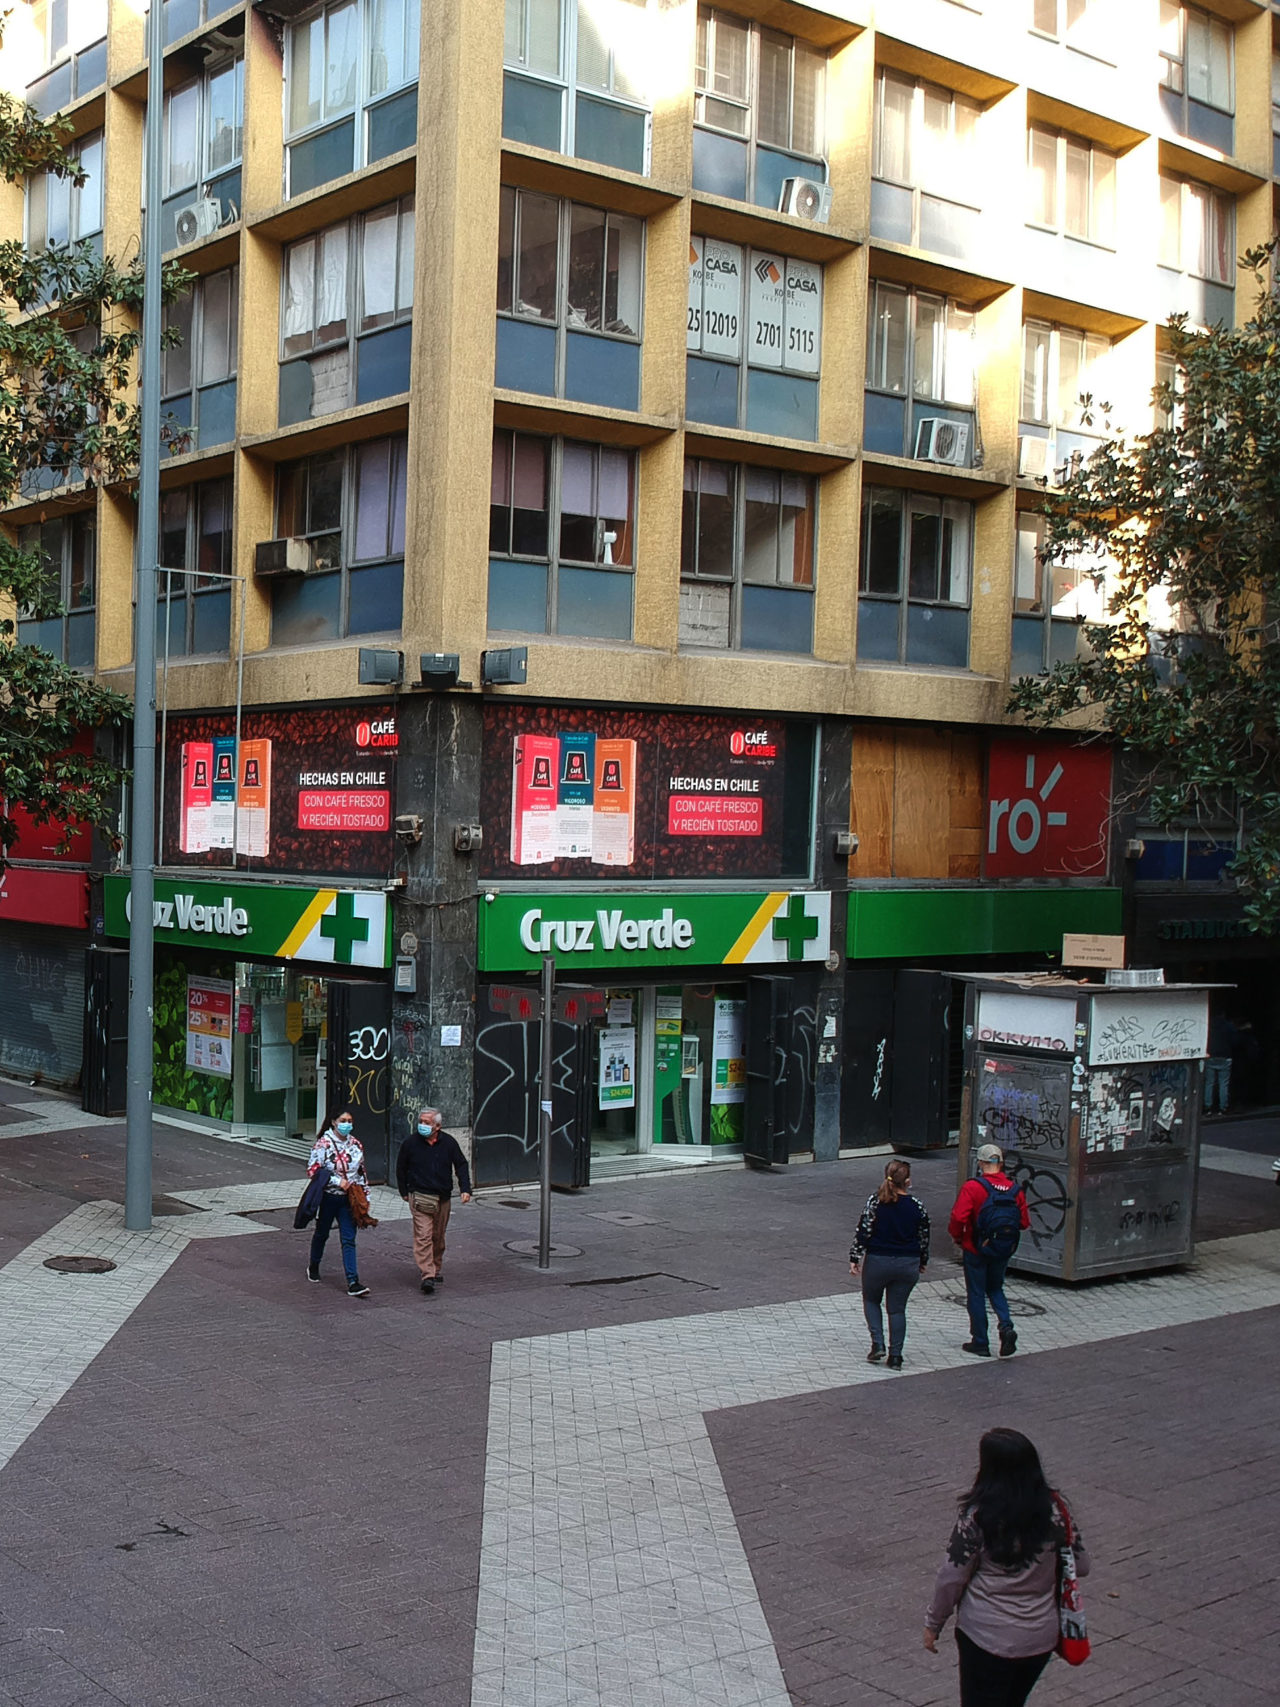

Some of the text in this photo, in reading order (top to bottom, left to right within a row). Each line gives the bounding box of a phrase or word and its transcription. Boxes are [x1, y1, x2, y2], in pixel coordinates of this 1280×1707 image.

[706, 258, 738, 276] CASA
[787, 277, 818, 295] CASA
[705, 310, 738, 339] 12019
[756, 321, 814, 354] 2701 5115
[371, 718, 395, 735] CAFÉ
[745, 730, 768, 745] CAFÉ
[745, 745, 777, 757] CARIBE
[299, 772, 386, 786] HECHAS EN CHILE
[670, 776, 759, 792] HECHAS EN CHILE
[304, 793, 385, 808] CON CAFÉ FRESCO
[675, 799, 758, 814] CON CAFÉ FRESCO
[302, 811, 385, 827] Y RECIÉN TOSTADO
[673, 817, 758, 832] Y RECIÉN TOSTADO
[175, 894, 248, 936] Verde
[520, 908, 692, 952] Cruz Verde
[190, 990, 208, 1006] 20%
[189, 1010, 207, 1026] 25%
